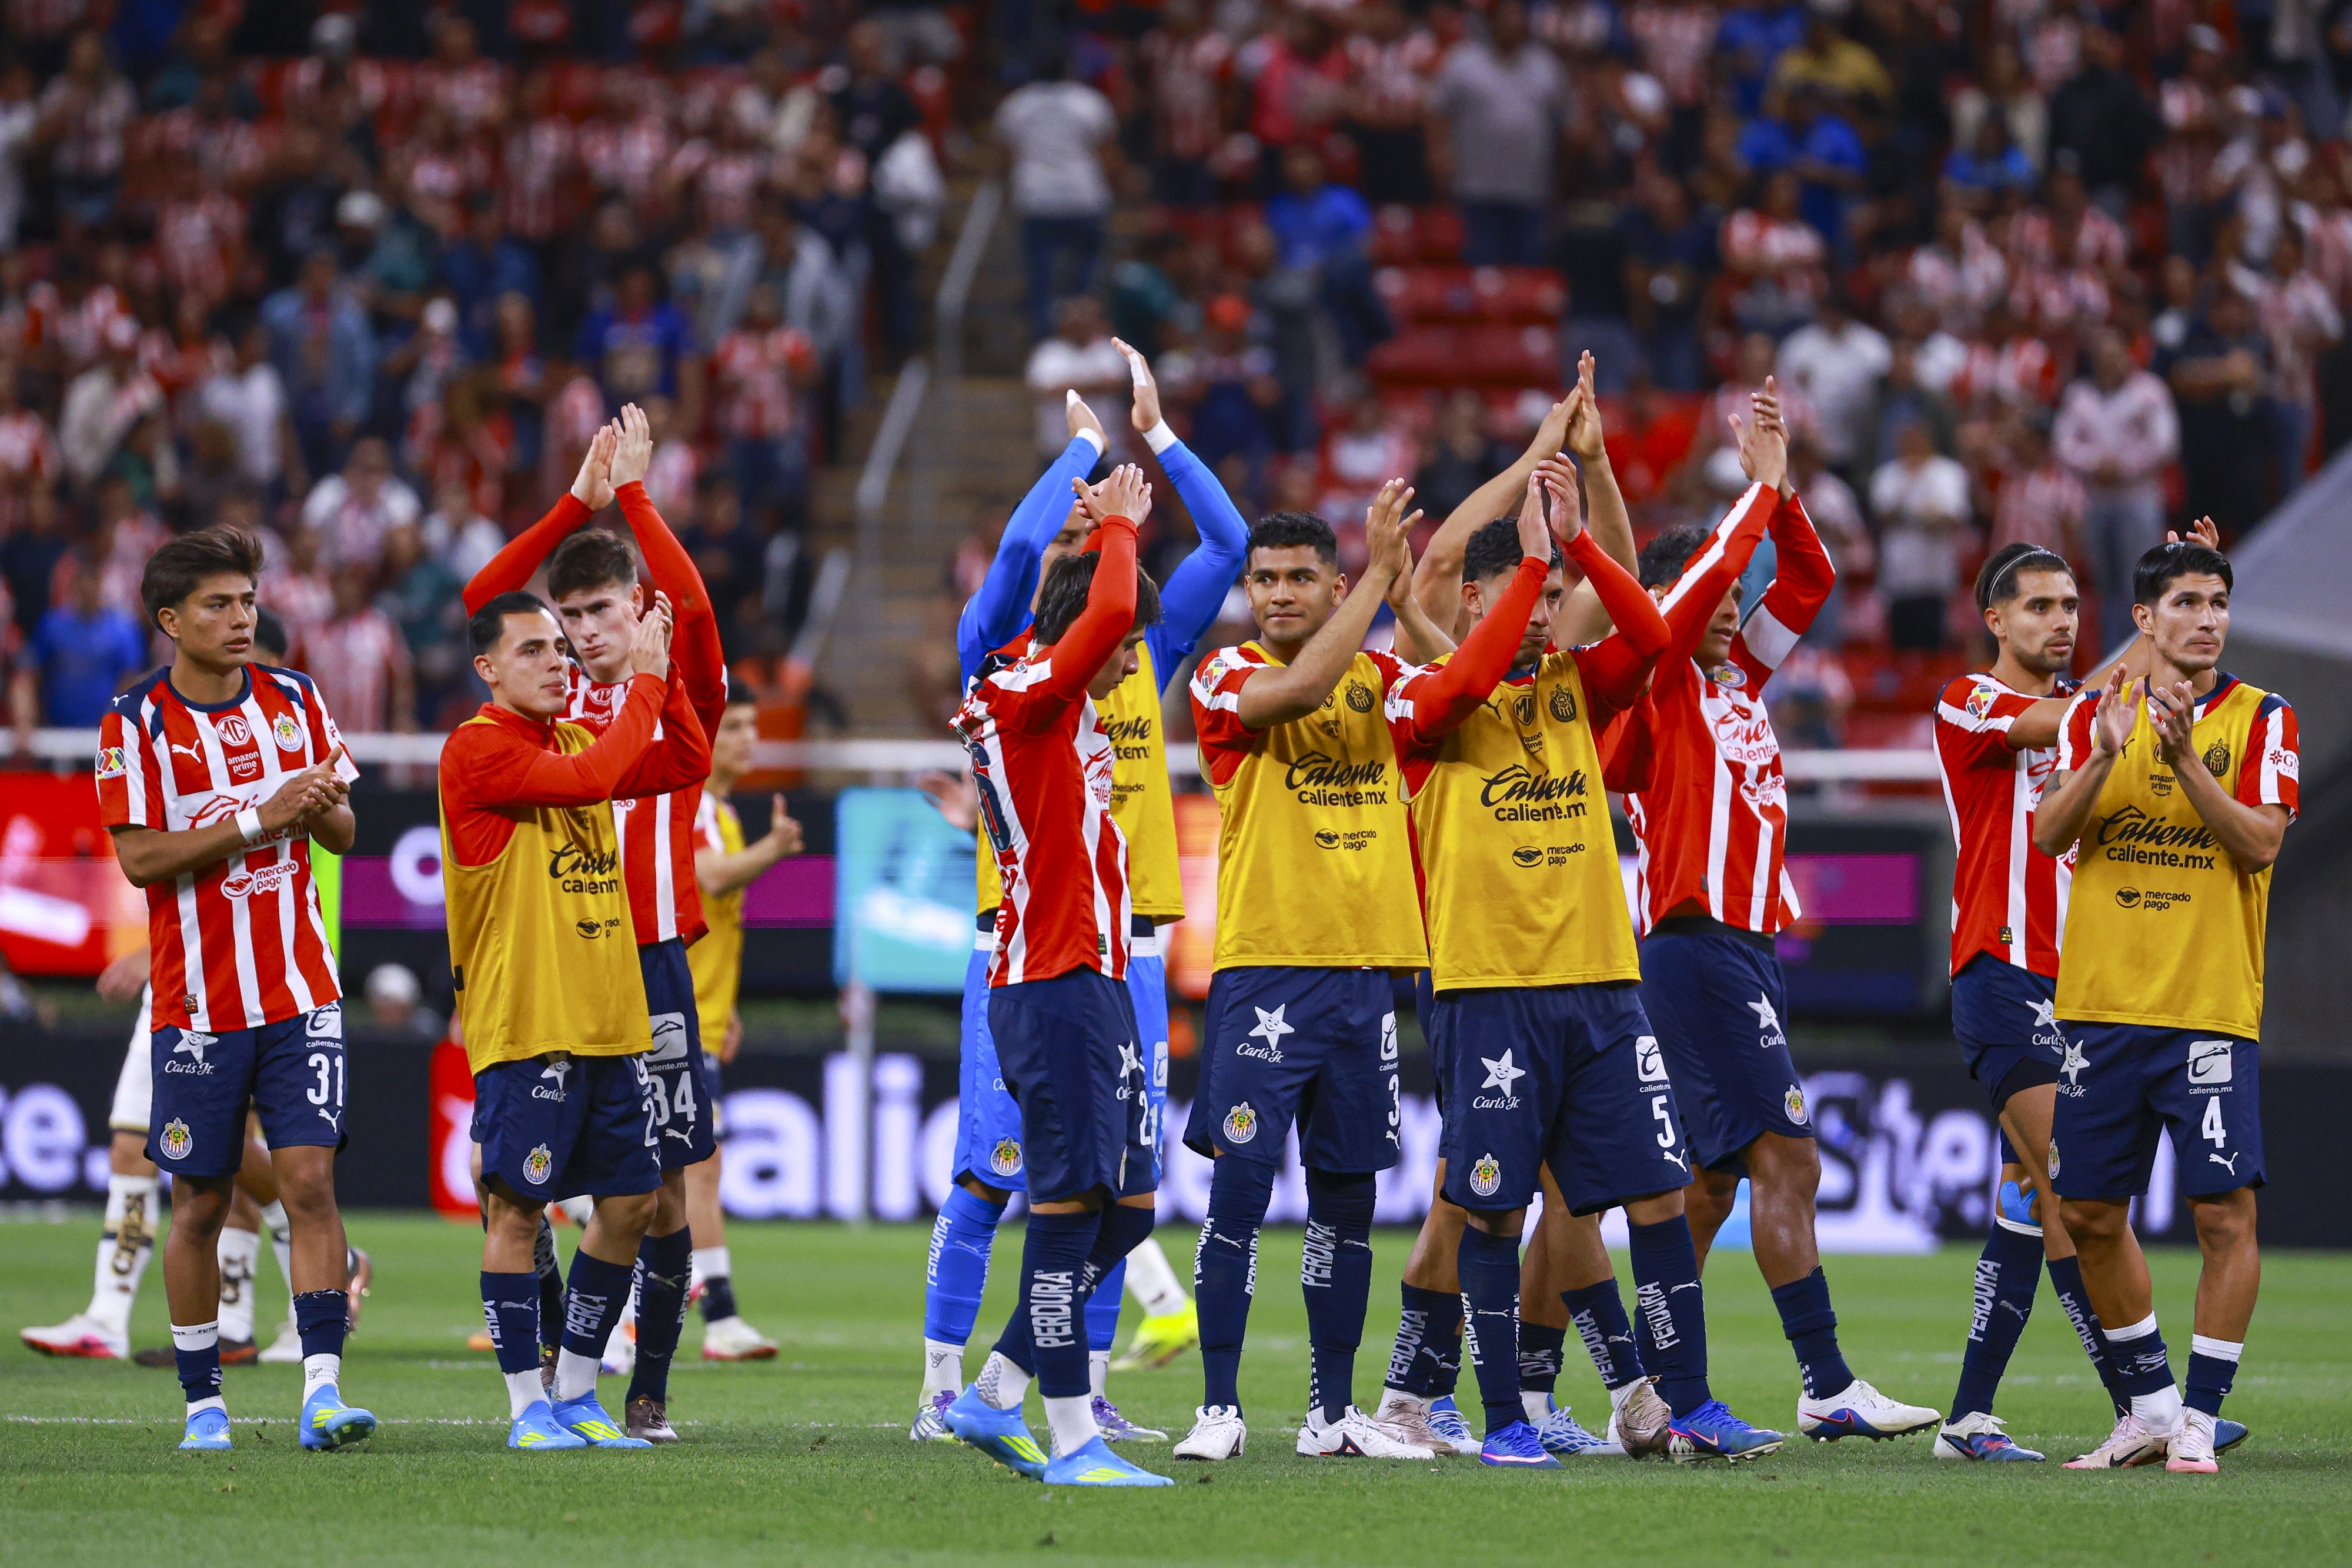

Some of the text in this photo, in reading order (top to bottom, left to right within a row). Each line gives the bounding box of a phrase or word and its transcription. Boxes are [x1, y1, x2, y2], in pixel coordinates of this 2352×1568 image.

[219, 719, 245, 742] MG
[227, 751, 259, 765] amazon
[233, 760, 257, 775] prime
[2283, 754, 2299, 770] GN
[1480, 763, 1587, 808] Caliente
[2149, 773, 2176, 783] amazon
[2151, 782, 2172, 791] prime
[1298, 788, 1388, 807] caliente.mx
[1342, 829, 1377, 840] mercado
[1343, 840, 1368, 851] pago
[2106, 844, 2216, 870] caliente.mx
[256, 862, 296, 880] mercado
[257, 877, 282, 891] pago
[2144, 900, 2170, 911] pago
[2145, 891, 2191, 902] mercado
[306, 1039, 343, 1049] caliente.mx
[1236, 1042, 1284, 1064] Carl's Jr.
[164, 1059, 214, 1075] Carl's Jr.
[306, 1052, 343, 1107] 31
[2056, 1079, 2087, 1098] arl's Jr.
[532, 1085, 558, 1101] Carl's
[649, 1071, 697, 1126] 34
[2189, 1086, 2233, 1095] caliente.mx
[1388, 1074, 1400, 1127] 3
[1472, 1096, 1521, 1111] Carl's Jr.
[1651, 1094, 1676, 1148] 5
[2201, 1095, 2227, 1149] 4
[1300, 1219, 1337, 1288] PERDURA
[1030, 1271, 1075, 1348] PERDURA
[1968, 1259, 2002, 1342] PERDURA
[1636, 1281, 1681, 1350] PERDURA
[1385, 1310, 1429, 1385] PERDURA
[1572, 1308, 1618, 1385] PERDURA
